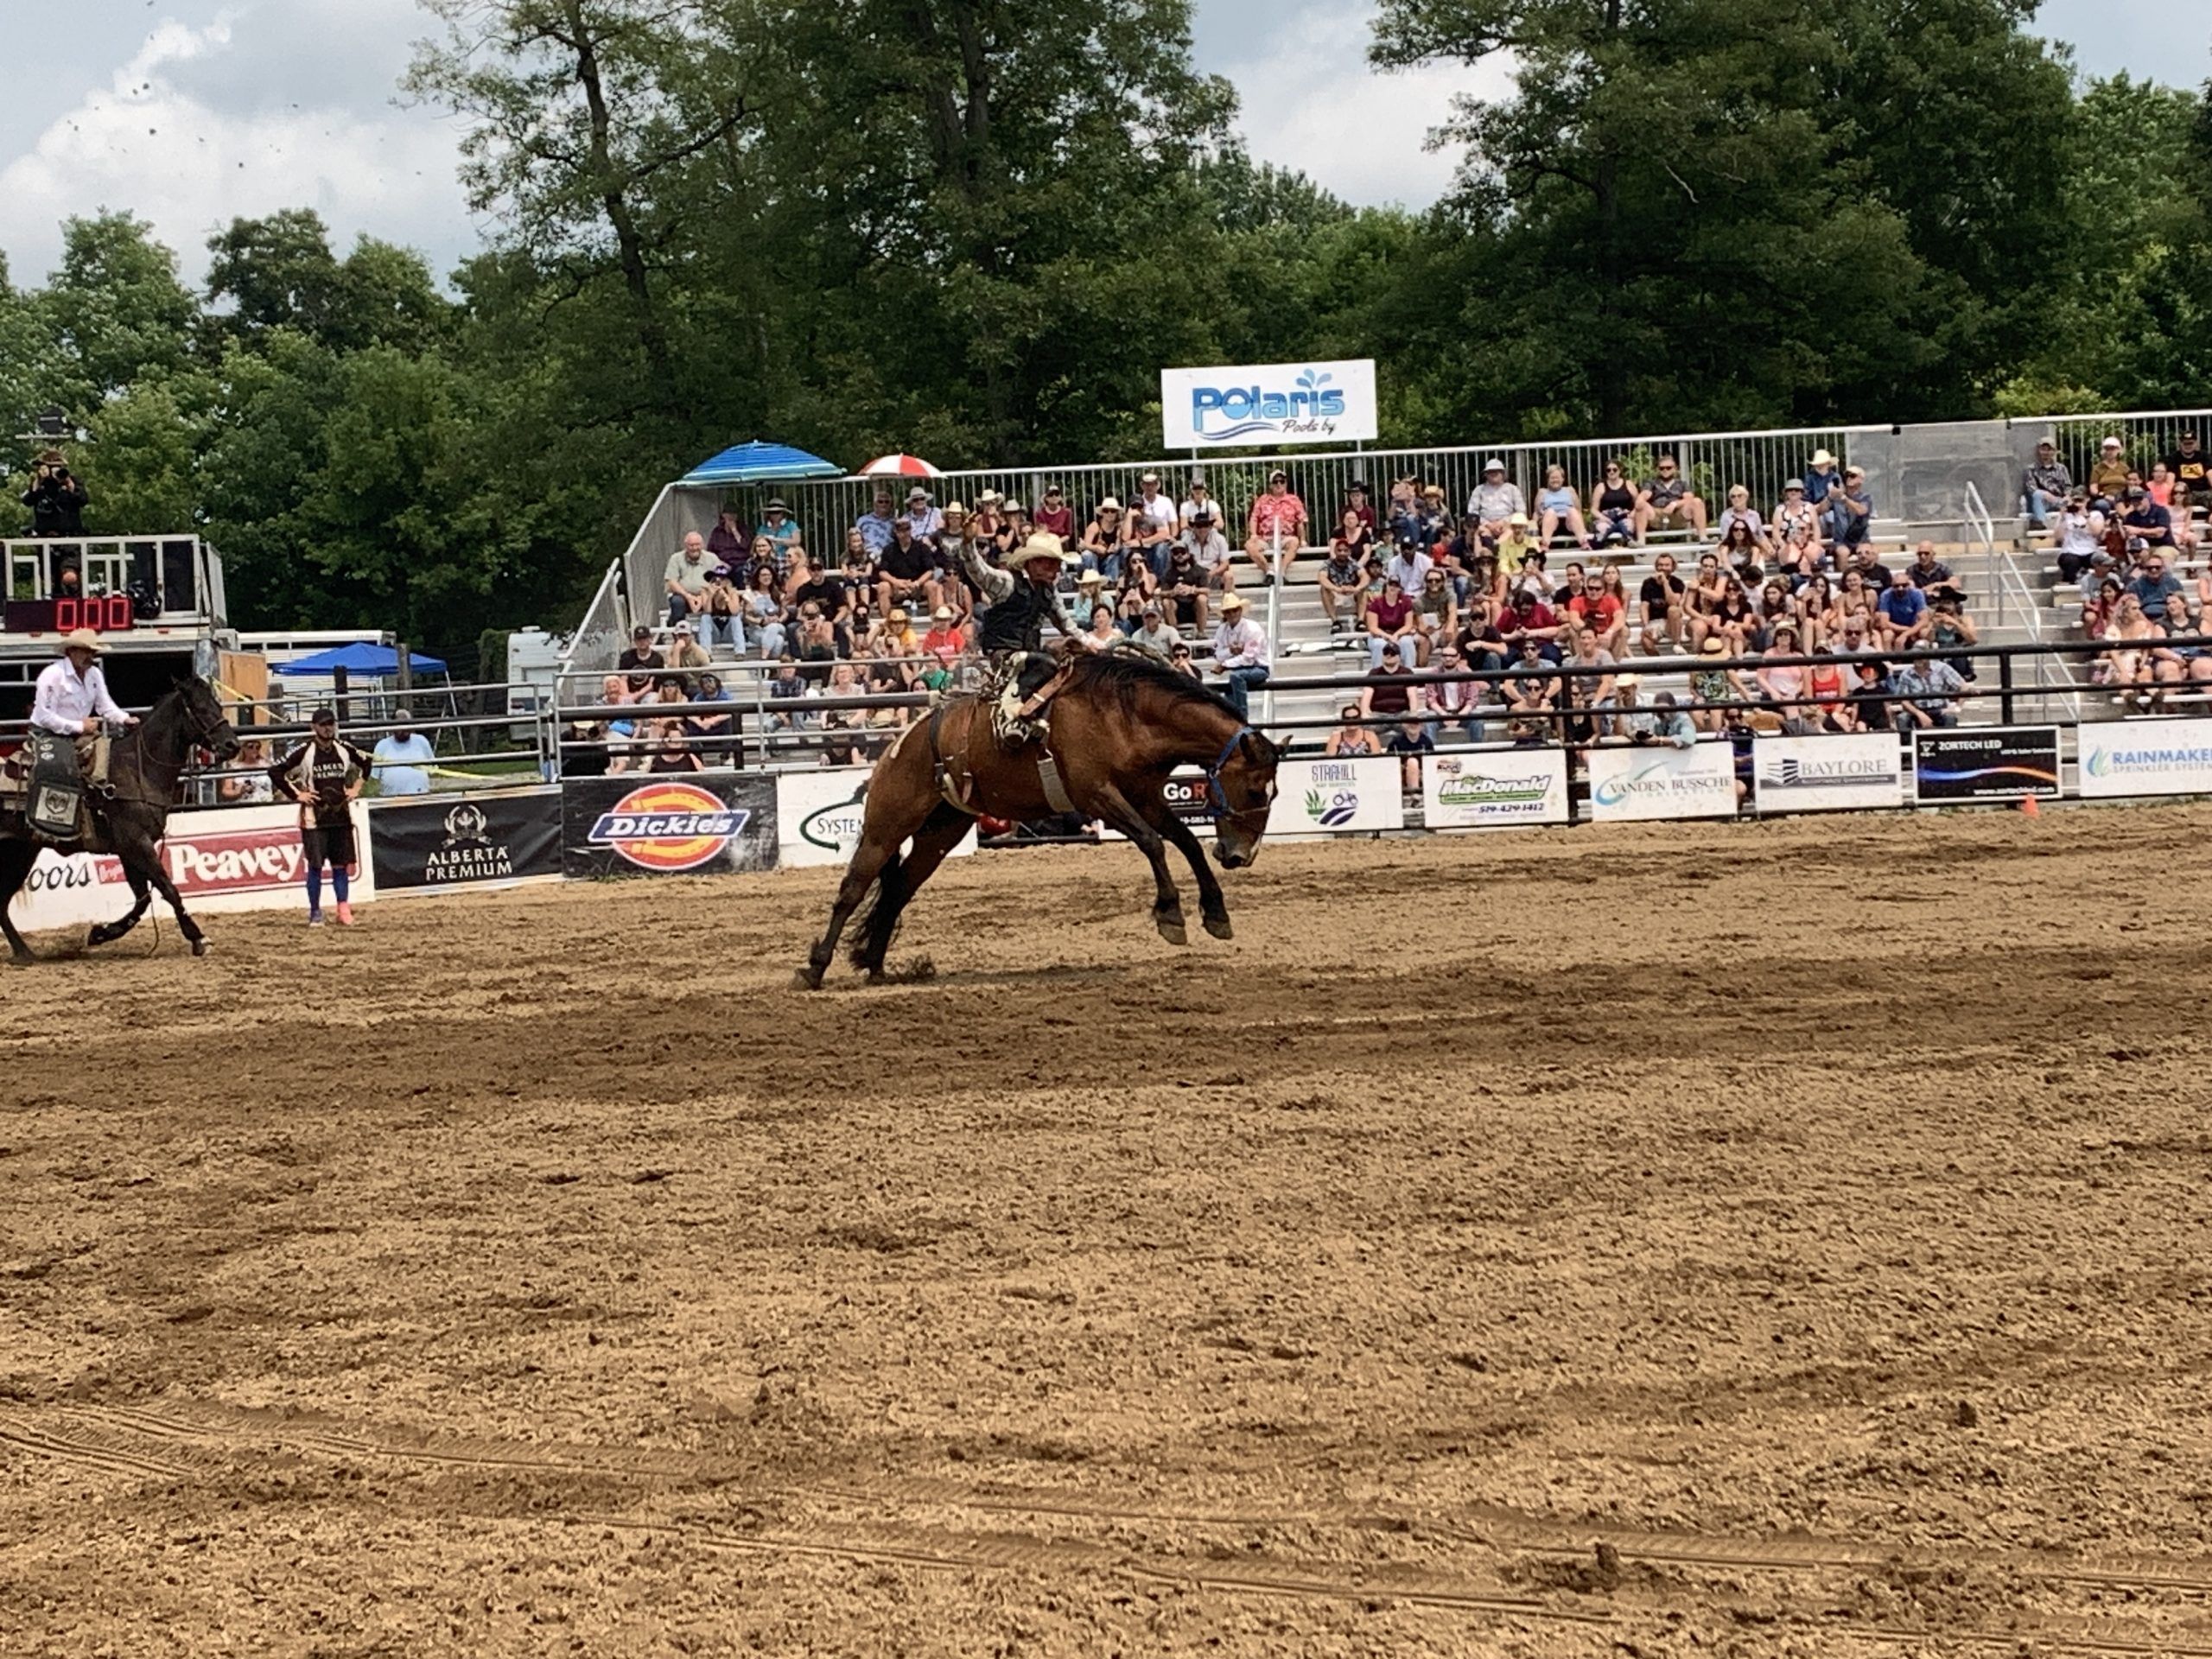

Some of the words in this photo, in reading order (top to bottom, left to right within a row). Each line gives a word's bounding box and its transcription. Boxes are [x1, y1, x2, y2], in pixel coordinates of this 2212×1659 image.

[1192, 385, 1345, 432] Polaris
[1282, 418, 1319, 433] Pools
[1320, 418, 1338, 435] by
[1984, 740, 2002, 749] LED
[2113, 748, 2212, 765] RAINMAKE
[1802, 759, 1887, 775] BAYLORE
[1440, 775, 1552, 796] MacDonald
[1610, 780, 1666, 793] VANDEN
[605, 816, 734, 836] Dickies
[167, 842, 303, 885] Peavey
[428, 846, 508, 866] ALBERTA
[27, 863, 92, 892] oors
[426, 861, 512, 881] PREMIUM
